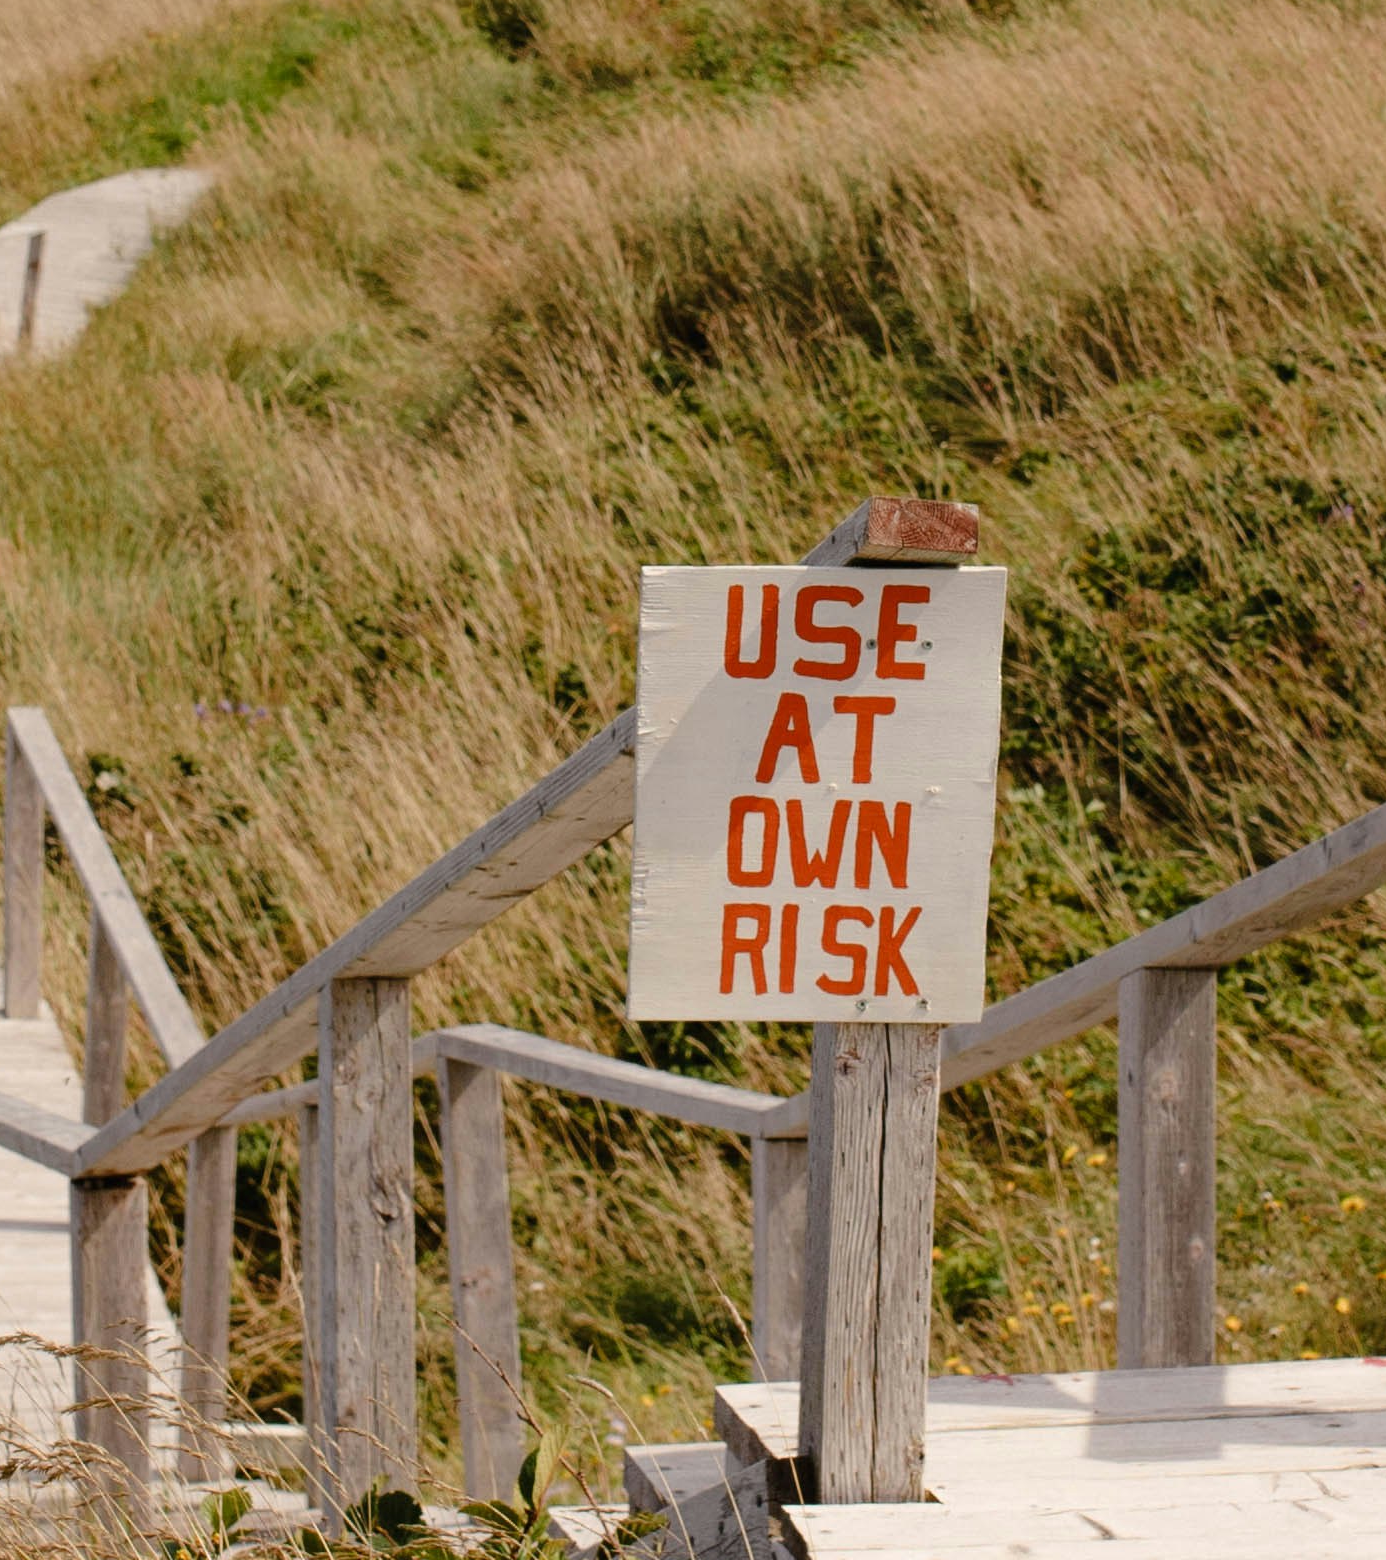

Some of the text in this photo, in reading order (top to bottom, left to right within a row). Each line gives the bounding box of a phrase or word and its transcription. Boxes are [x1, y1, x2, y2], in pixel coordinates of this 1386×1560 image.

[724, 584, 930, 681] USE
[756, 692, 896, 784] AT
[726, 796, 912, 889] OWN
[719, 903, 922, 996] RISK
